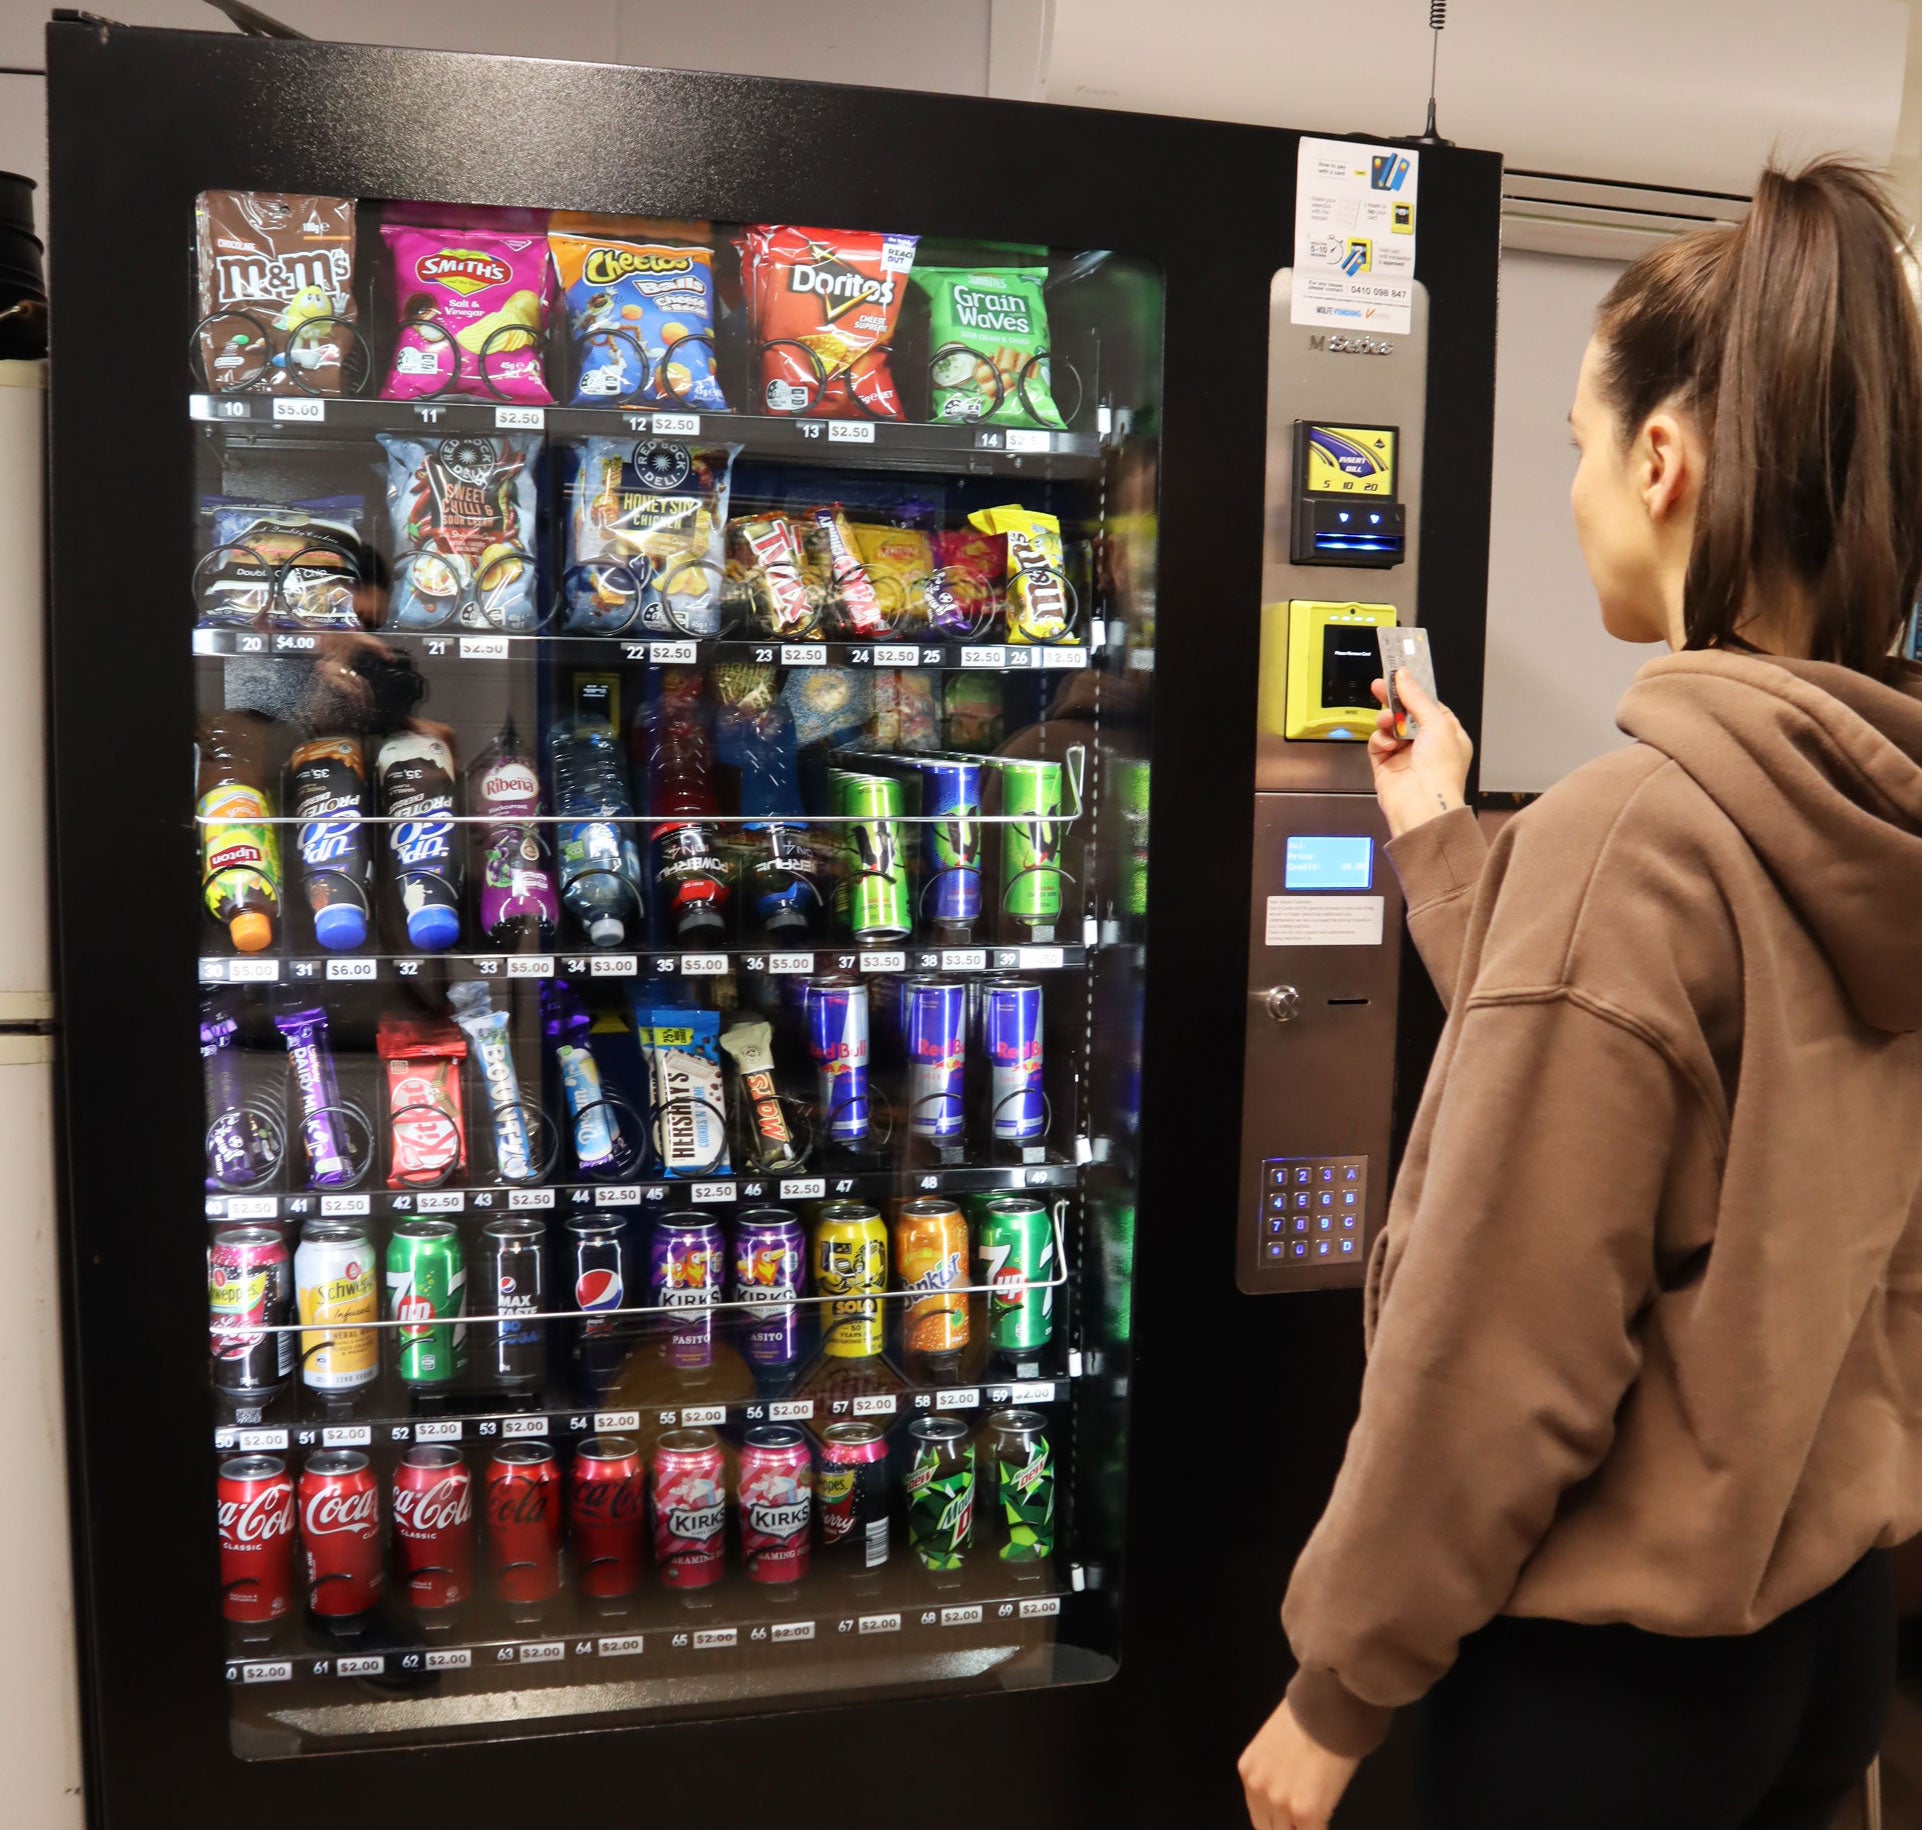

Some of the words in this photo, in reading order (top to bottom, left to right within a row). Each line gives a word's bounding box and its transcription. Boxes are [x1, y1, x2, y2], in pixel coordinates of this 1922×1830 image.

[421, 256, 505, 283] SMITH'S
[584, 249, 693, 286] Cheetos
[633, 277, 706, 296] Balls
[791, 265, 894, 304] Doritos
[1350, 285, 1371, 295] 0410
[1373, 287, 1389, 297] 098
[1391, 289, 1407, 298] 847
[449, 299, 468, 309] Salt
[470, 300, 480, 309] &
[953, 285, 1026, 313] Grain
[445, 307, 485, 320] Vinegar
[956, 304, 1030, 333] Waves
[224, 403, 243, 417] 10
[277, 404, 319, 417] $5.00
[422, 409, 438, 423] 11
[499, 412, 540, 425] $2.50
[629, 418, 647, 431] 12
[655, 419, 694, 431] $2.50
[803, 426, 820, 439] 13
[831, 426, 869, 438] $2.50
[981, 433, 998, 447] 14
[644, 471, 678, 487] DELI
[1323, 480, 1330, 489] 5
[1342, 481, 1354, 490] 10
[1364, 482, 1378, 492] 20
[243, 637, 262, 651] 20
[277, 636, 315, 649] $4.00
[429, 641, 445, 655] 21
[627, 646, 644, 660] 22
[653, 647, 691, 659] $2.50
[755, 649, 773, 662] 23
[785, 649, 822, 661] $2.50
[852, 652, 870, 663] 24
[877, 651, 914, 663] $2.50
[923, 650, 941, 663] 25
[965, 651, 1000, 663] $2.50
[1011, 651, 1028, 665] 26
[486, 778, 535, 796] Ribena
[211, 847, 262, 866] Lipton
[684, 960, 722, 972] $5.00
[747, 958, 764, 971] 36
[772, 959, 809, 970] $5.00
[839, 956, 855, 969] 37
[863, 955, 900, 967] $3.50
[921, 954, 938, 968] 38
[946, 954, 981, 967] $3.50
[1000, 953, 1017, 966] 39
[296, 963, 313, 977] 31
[332, 965, 371, 976] $6.00
[400, 962, 418, 976] 32
[480, 961, 498, 975] 33
[511, 962, 549, 974] $5.00
[568, 960, 586, 974] 34
[594, 961, 633, 973] $3.00
[657, 960, 674, 973] 35
[293, 1048, 314, 1092] DAIRY
[1031, 1171, 1049, 1184] 49
[1276, 1171, 1283, 1183] 1
[1299, 1170, 1307, 1182] 2
[1323, 1169, 1332, 1180] 3
[1347, 1168, 1356, 1179] A
[744, 1183, 763, 1196] 46
[783, 1184, 820, 1196] $2.50
[836, 1179, 853, 1193] 47
[920, 1177, 938, 1190] 48
[474, 1193, 492, 1206] 43
[572, 1189, 590, 1203] 44
[598, 1189, 637, 1201] $2.50
[646, 1188, 664, 1201] 45
[695, 1187, 732, 1199] $2.50
[290, 1199, 308, 1213] 41
[324, 1199, 365, 1211] $2.50
[393, 1196, 412, 1210] 42
[420, 1197, 460, 1208] $2.50
[512, 1194, 551, 1206] $2.50
[1273, 1197, 1282, 1208] 4
[1298, 1195, 1307, 1206] 5
[1322, 1194, 1331, 1205] 6
[1345, 1193, 1354, 1203] B
[231, 1202, 273, 1213] $2.50
[1273, 1221, 1281, 1232] 7
[1296, 1219, 1305, 1230] 8
[1321, 1218, 1329, 1229] 9
[1344, 1217, 1353, 1227] C
[1295, 1244, 1304, 1255] 0
[1343, 1241, 1352, 1251] D
[499, 1294, 532, 1307] MAX
[663, 1290, 721, 1309] KIRKS
[334, 1306, 372, 1321] Infused
[835, 1299, 875, 1315] SOLO
[672, 1334, 711, 1345] PASITO
[915, 1395, 931, 1408] 58
[939, 1394, 974, 1406] $2.00
[992, 1389, 1008, 1402] 59
[773, 1404, 809, 1416] $2.00
[833, 1401, 849, 1414] 57
[856, 1399, 892, 1411] $2.00
[659, 1412, 676, 1424] 55
[684, 1411, 721, 1423] $2.00
[746, 1407, 764, 1419] 56
[479, 1422, 497, 1435] 53
[505, 1421, 544, 1433] $2.00
[570, 1417, 588, 1430] 54
[598, 1416, 635, 1428] $2.00
[327, 1428, 366, 1440] $2.00
[391, 1427, 410, 1440] 52
[418, 1424, 457, 1436] $2.00
[215, 1436, 234, 1448] 50
[243, 1434, 283, 1447] $2.00
[299, 1431, 315, 1444] 51
[675, 1511, 726, 1533] KIRKS
[756, 1507, 809, 1527] KIRKS
[400, 1529, 437, 1540] CLASSIC
[223, 1542, 263, 1552] CLASSIC
[998, 1604, 1014, 1617] 69
[1022, 1602, 1057, 1615] $2.00
[921, 1612, 937, 1625] 68
[944, 1611, 979, 1623] $2.00
[838, 1620, 854, 1633] 67
[861, 1618, 896, 1630] $2.00
[697, 1632, 734, 1643] $2.00
[751, 1628, 767, 1640] 66
[774, 1626, 810, 1638] $2.00
[601, 1640, 639, 1652] $2.00
[672, 1634, 688, 1647] 65
[522, 1646, 560, 1659] $2.00
[575, 1641, 592, 1654] 64
[402, 1654, 419, 1667] 62
[428, 1654, 467, 1666] $2.00
[498, 1648, 514, 1661] 63
[246, 1665, 286, 1678] $2.00
[314, 1660, 329, 1674] 61
[340, 1659, 379, 1672] $2.00
